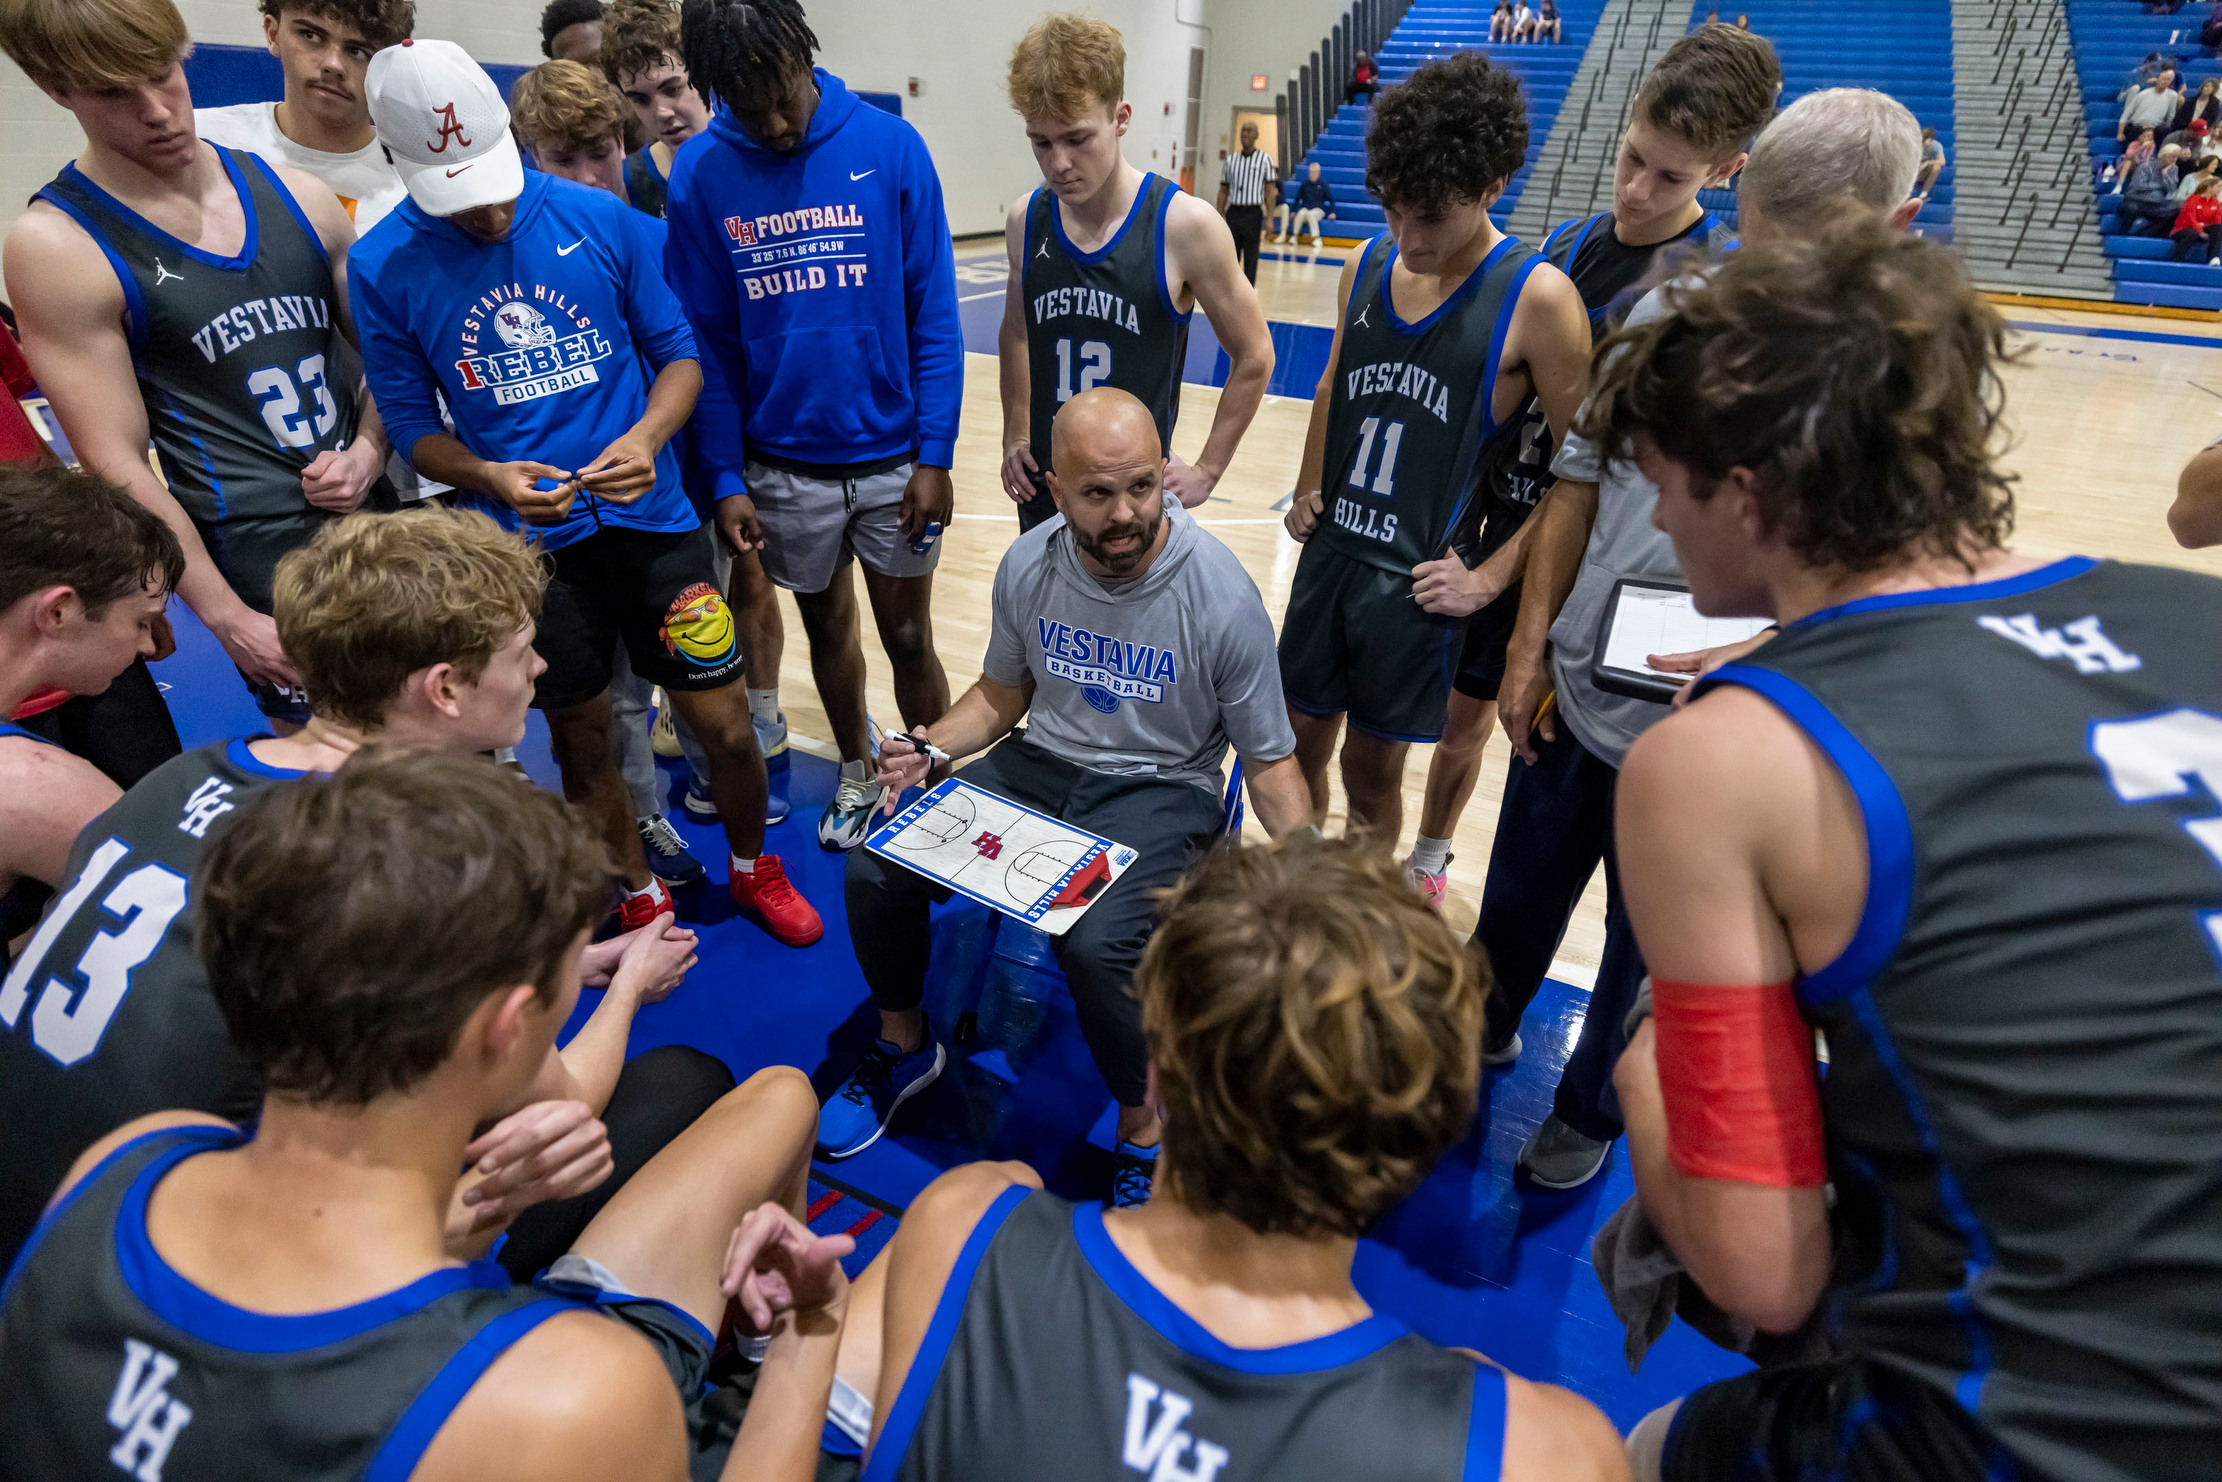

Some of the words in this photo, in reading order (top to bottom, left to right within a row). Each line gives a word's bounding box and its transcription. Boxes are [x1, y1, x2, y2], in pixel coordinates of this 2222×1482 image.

[427, 102, 472, 153] A
[755, 204, 863, 238] FOOTBALL
[743, 266, 827, 300] BUILD
[836, 263, 868, 287] IT
[1033, 286, 1141, 336] VESTAVIA
[190, 295, 329, 364] VESTAVIA
[461, 282, 524, 357] VESTAVIA
[534, 283, 591, 330] HILLS
[501, 370, 591, 402] FOOTBALL
[1055, 337, 1113, 402] 12
[1347, 362, 1449, 424] VESTAVIA
[246, 353, 338, 449] 23
[1348, 416, 1405, 497] 11
[1333, 496, 1398, 543] HILLS
[1037, 615, 1178, 685] VESTAVIA
[1976, 612, 2143, 674] VH
[1050, 660, 1155, 699] BASKETBALL
[178, 775, 236, 839] VH
[886, 791, 943, 835] REBELS
[0, 835, 191, 1068] 13
[106, 1337, 193, 1482] VH
